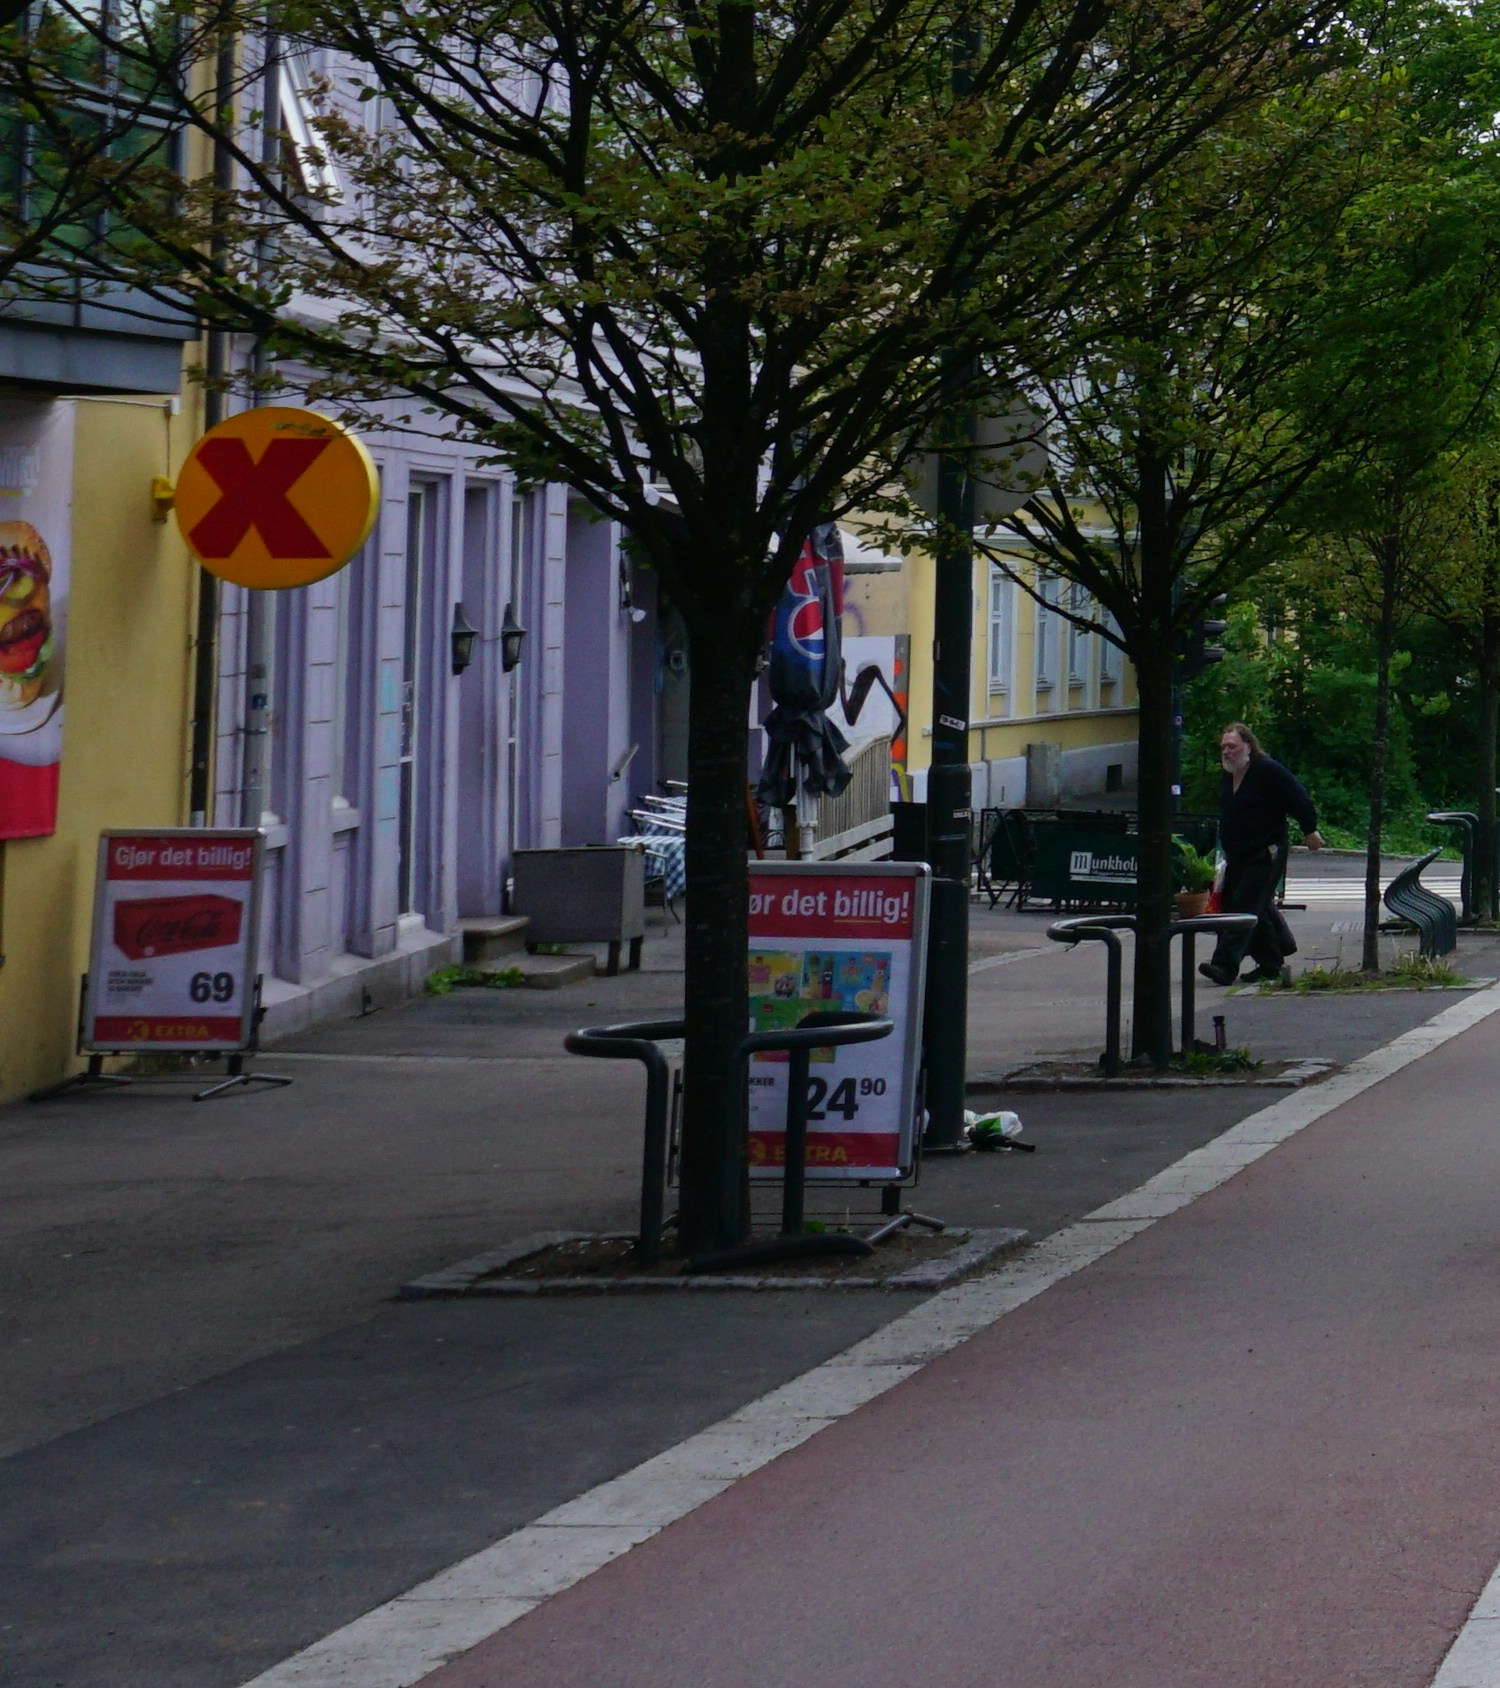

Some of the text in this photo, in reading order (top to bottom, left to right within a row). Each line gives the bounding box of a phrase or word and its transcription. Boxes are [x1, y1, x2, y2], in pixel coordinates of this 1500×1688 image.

[188, 437, 334, 559] X
[115, 845, 251, 871] Gjør det billig!
[781, 889, 827, 917] det
[833, 889, 911, 925] billig!
[190, 971, 235, 1004] 69
[153, 1023, 210, 1039] EXTRA
[804, 1076, 887, 1122] 24 90
[773, 1144, 848, 1163] ETRA
